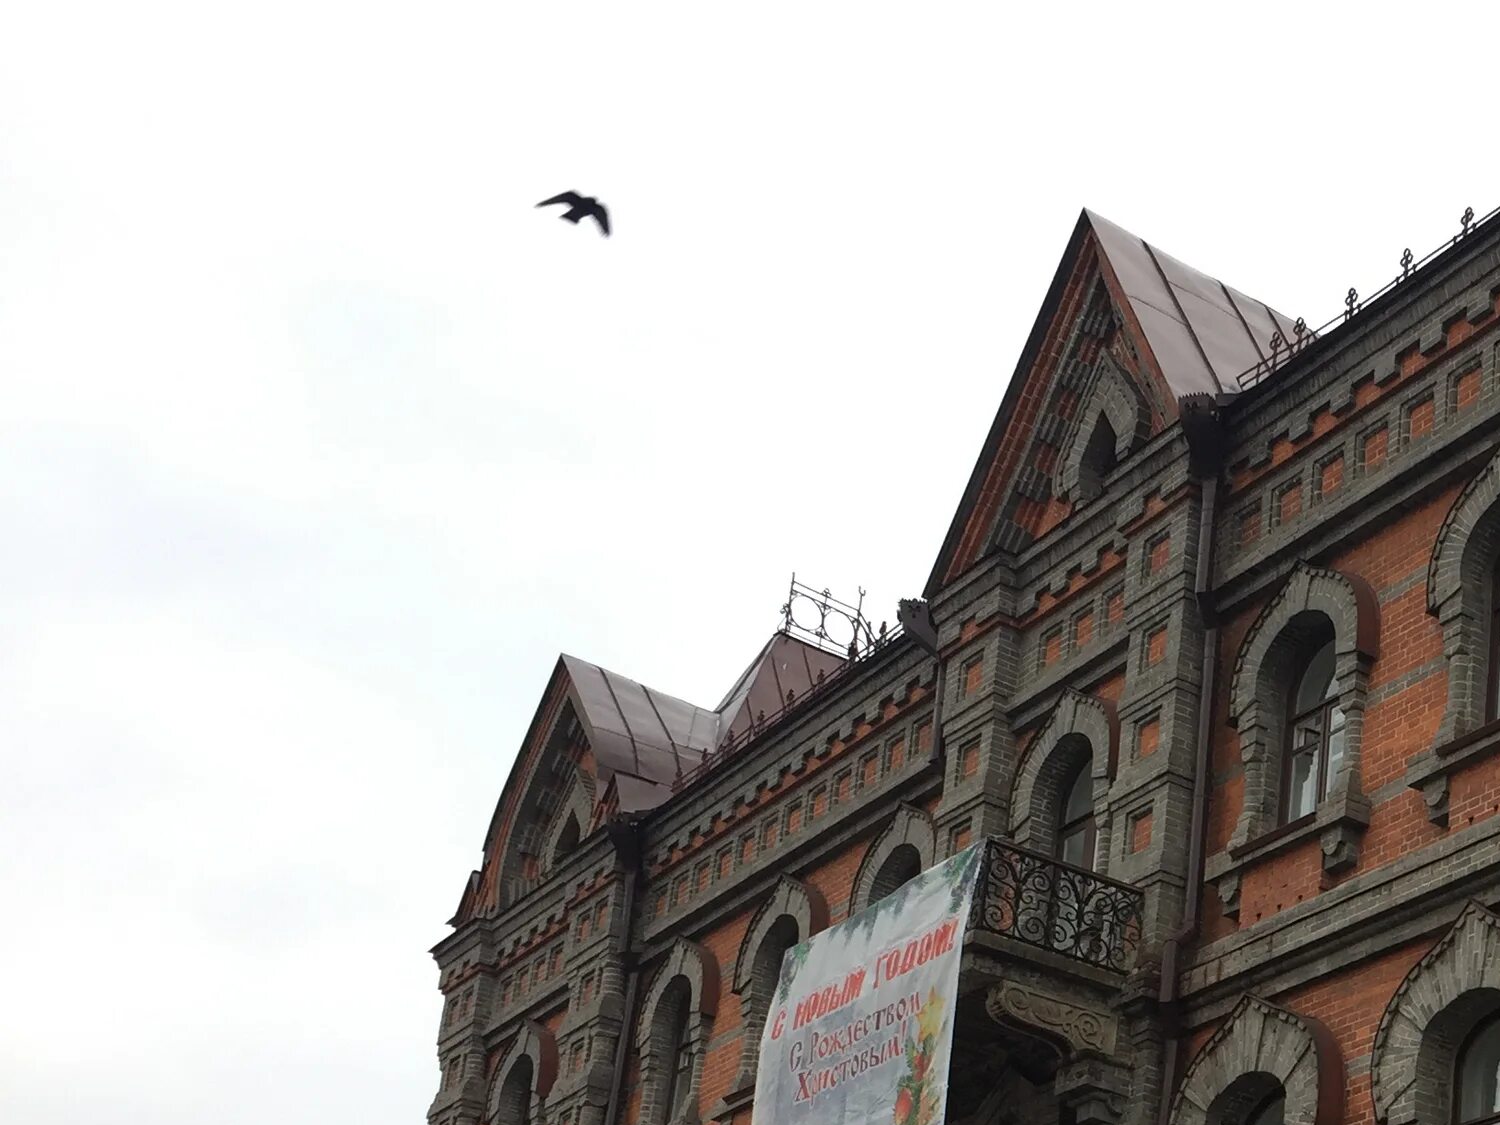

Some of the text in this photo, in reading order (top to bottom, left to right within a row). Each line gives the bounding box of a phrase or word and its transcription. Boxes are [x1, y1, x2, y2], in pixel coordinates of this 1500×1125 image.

[771, 1010, 787, 1041] С
[873, 919, 959, 989] ГОДОМ!
[789, 1040, 803, 1072] С
